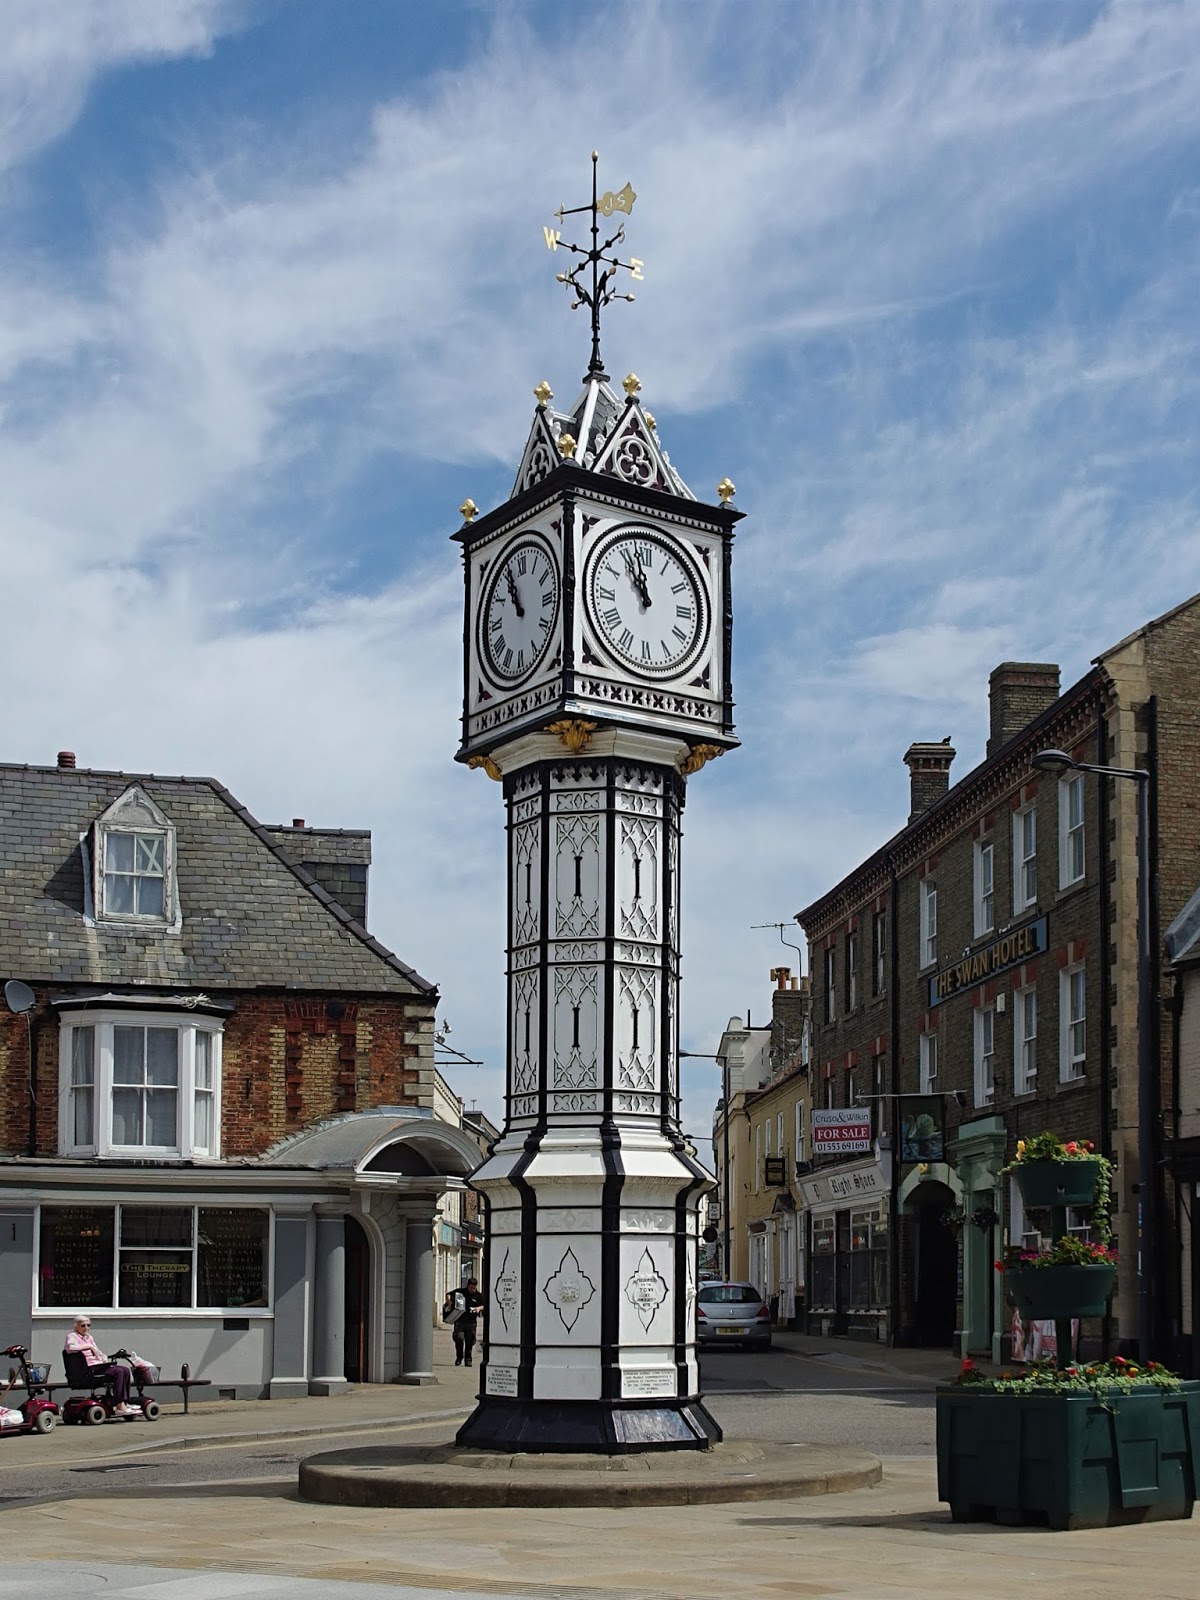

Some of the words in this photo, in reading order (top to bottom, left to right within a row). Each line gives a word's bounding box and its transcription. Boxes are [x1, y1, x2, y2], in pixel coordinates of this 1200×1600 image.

[543, 226, 561, 251] W
[631, 257, 645, 281] E
[517, 555, 527, 578] XII
[639, 547, 652, 568] XII
[538, 568, 550, 587] II
[605, 562, 621, 580] X
[600, 585, 616, 602] IX
[671, 582, 686, 595] II
[495, 595, 506, 607] X
[542, 591, 553, 608] III
[603, 607, 622, 631] VIII
[675, 604, 691, 620] III
[491, 617, 503, 633] IX
[538, 617, 549, 633] IV
[618, 627, 635, 651] VII
[671, 625, 688, 645] IV
[493, 634, 506, 659] VIII
[641, 640, 652, 660] VI
[661, 640, 671, 658] V
[502, 648, 514, 669] VII
[934, 968, 953, 998] THE
[955, 950, 988, 988] SWAN
[992, 927, 1033, 969] HOTEL
[817, 1129, 840, 1140] FOR
[842, 1127, 867, 1139] SALE
[817, 1142, 841, 1151] 01553
[841, 1141, 868, 1150] 691691
